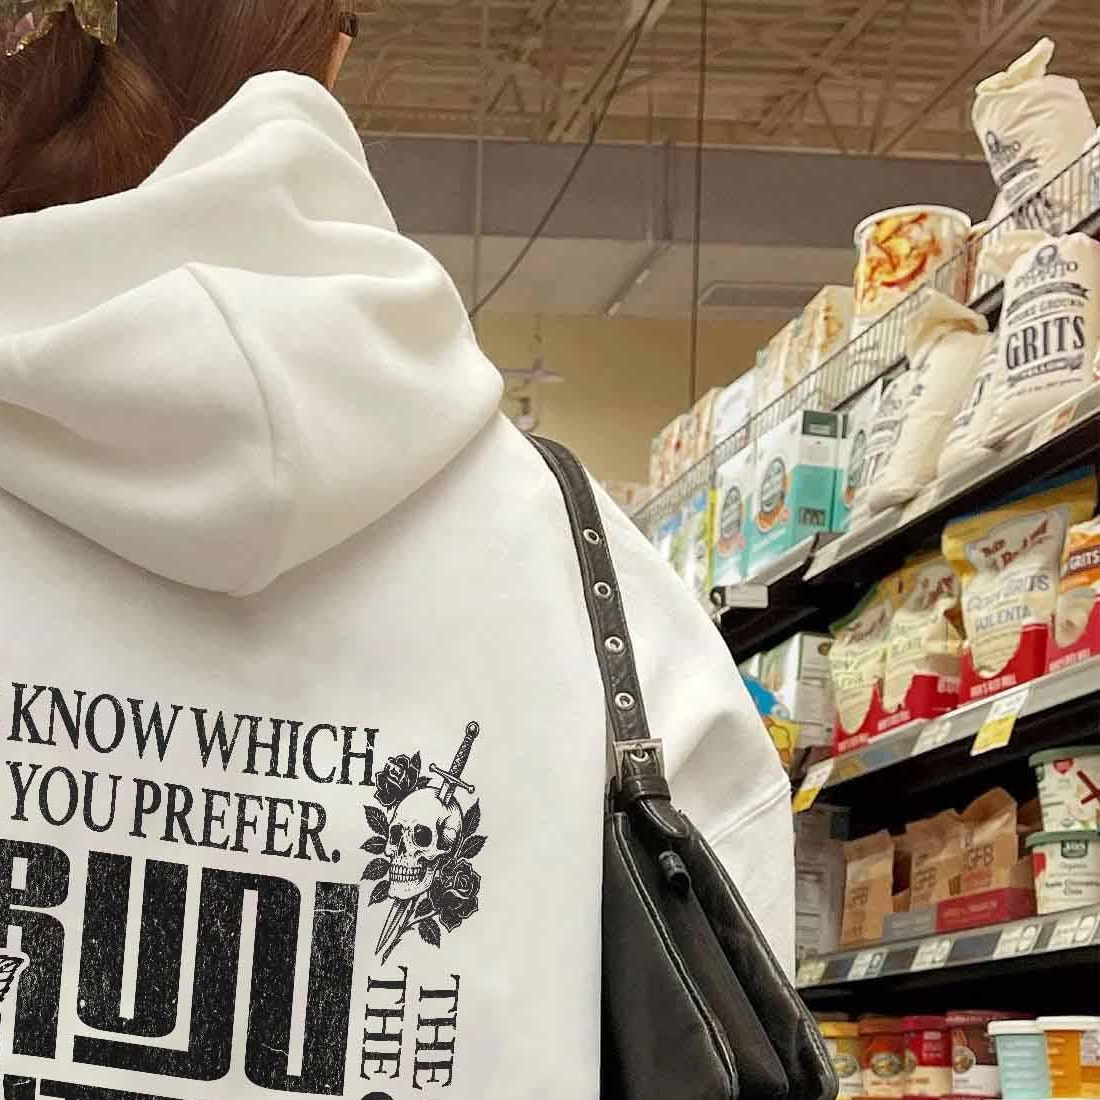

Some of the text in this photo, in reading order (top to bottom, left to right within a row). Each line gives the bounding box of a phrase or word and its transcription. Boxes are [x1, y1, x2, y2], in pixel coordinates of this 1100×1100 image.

[1006, 314, 1085, 370] GRITS
[6, 681, 184, 764] KNOW
[190, 706, 380, 788] WHICH
[6, 761, 123, 834] YOU
[128, 777, 342, 864] PREFER.
[359, 966, 409, 1081] THE
[411, 974, 461, 1091] THE
